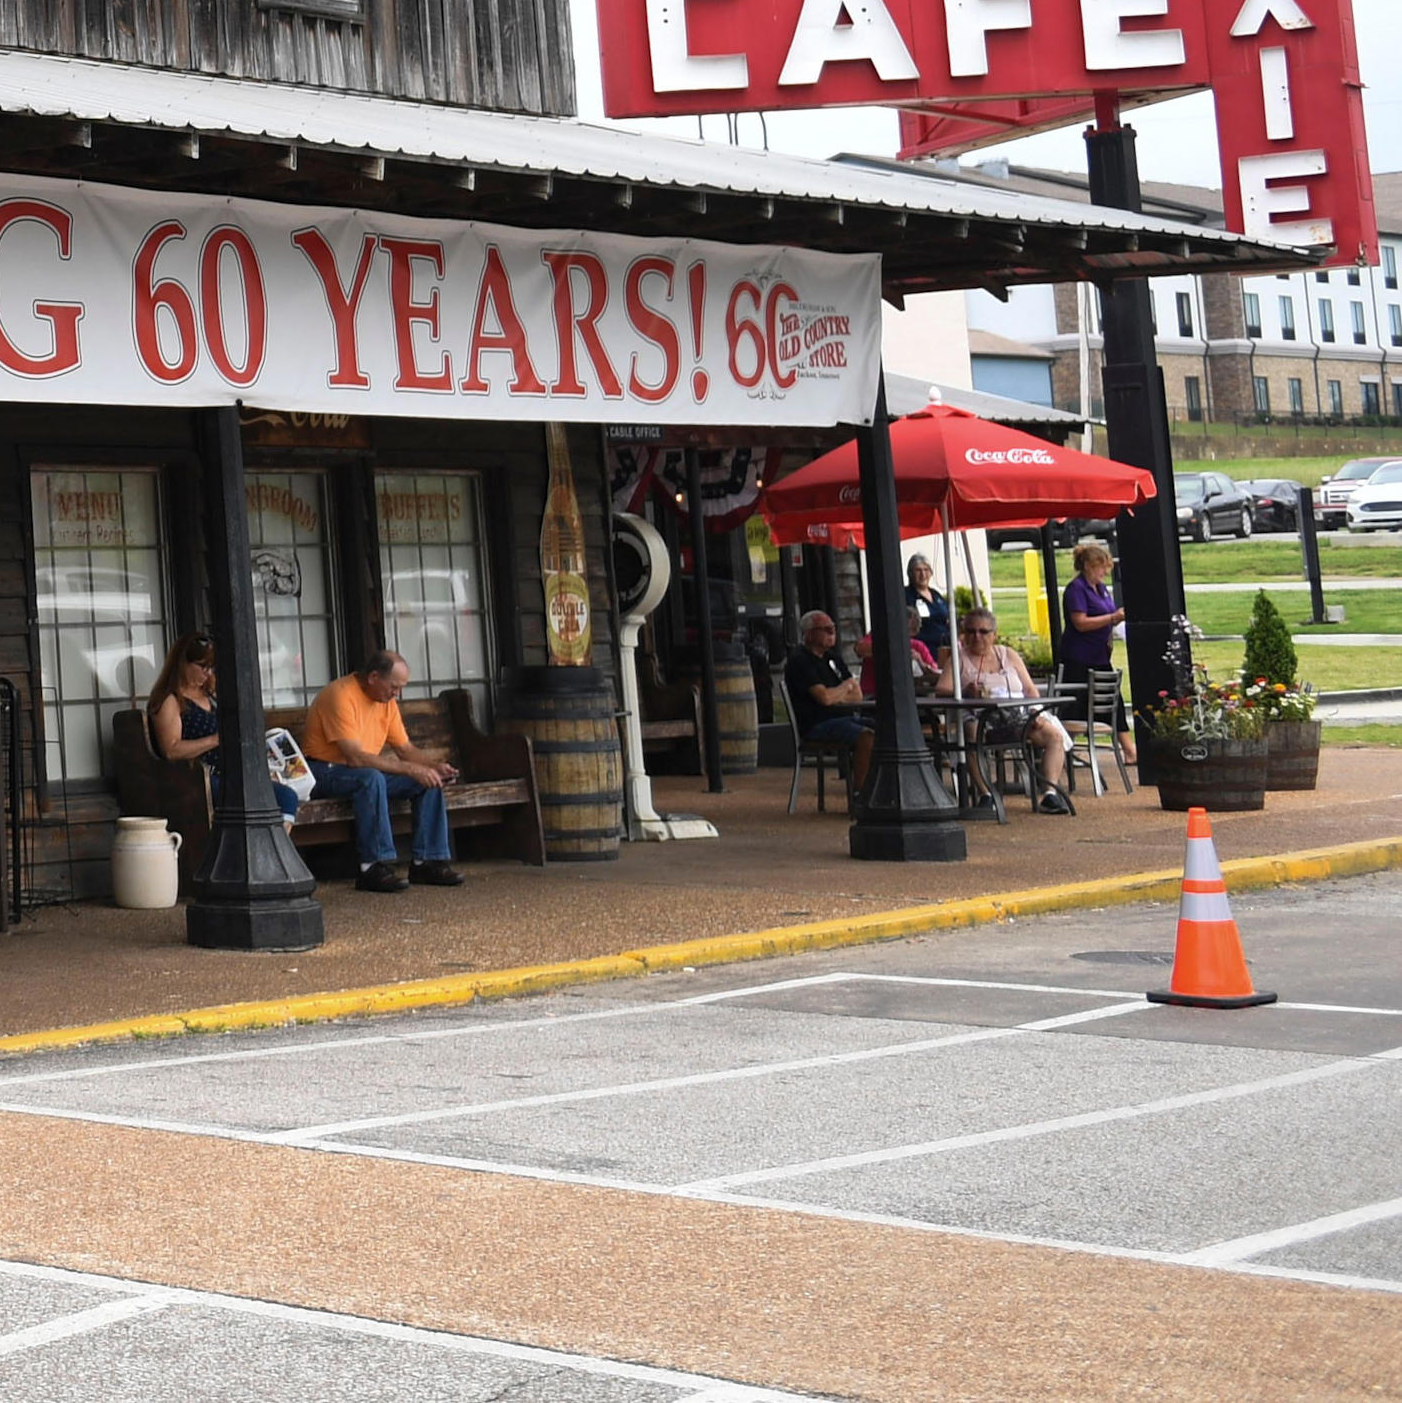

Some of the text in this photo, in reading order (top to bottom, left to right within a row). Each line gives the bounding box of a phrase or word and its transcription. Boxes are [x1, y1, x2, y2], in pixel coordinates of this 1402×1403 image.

[131, 219, 267, 388] 60
[290, 224, 708, 403] YEARS!
[779, 312, 800, 337] THE
[725, 278, 800, 389] 60
[779, 315, 851, 361] OLD COUNTRY
[808, 341, 847, 367] STORE
[609, 426, 661, 438] CABLE OFFICE
